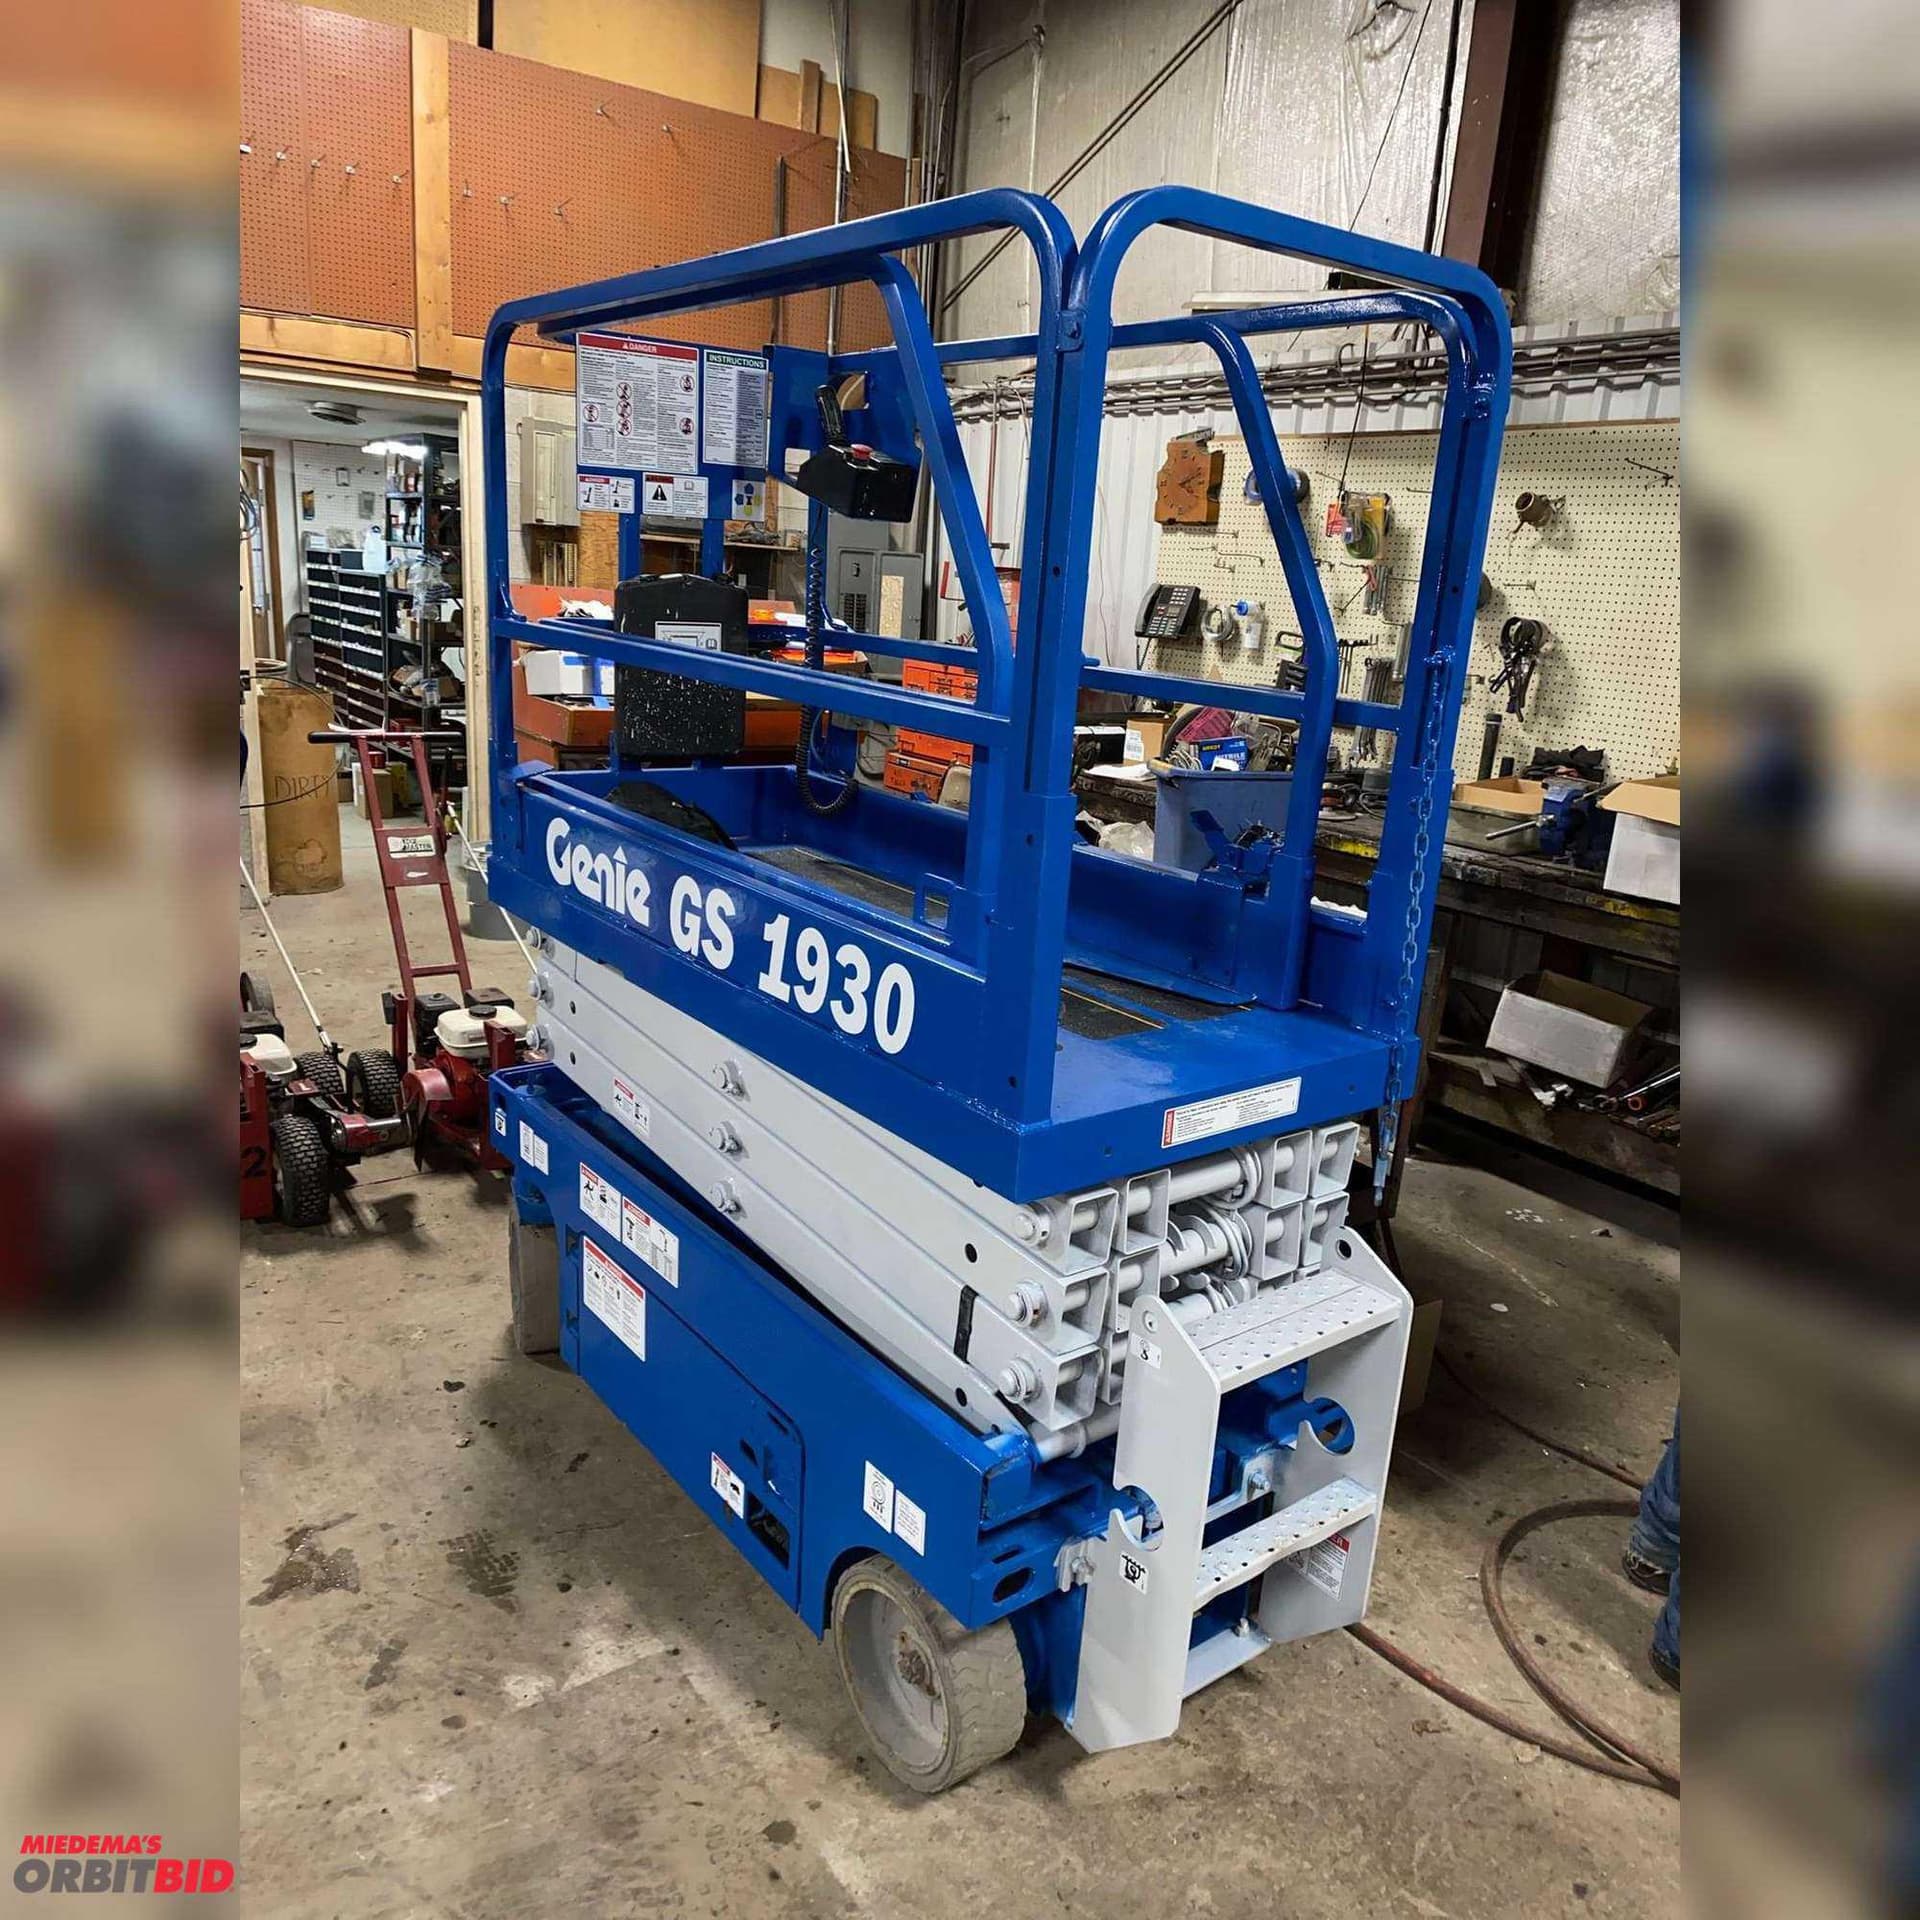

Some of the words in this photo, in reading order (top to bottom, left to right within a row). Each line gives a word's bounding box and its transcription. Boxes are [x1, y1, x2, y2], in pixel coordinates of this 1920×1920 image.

[629, 342, 657, 354] DANGER
[709, 354, 765, 368] INSTRUCTIONS
[546, 817, 651, 927] Genie
[669, 875, 736, 970] GS
[758, 913, 915, 1055] 1930
